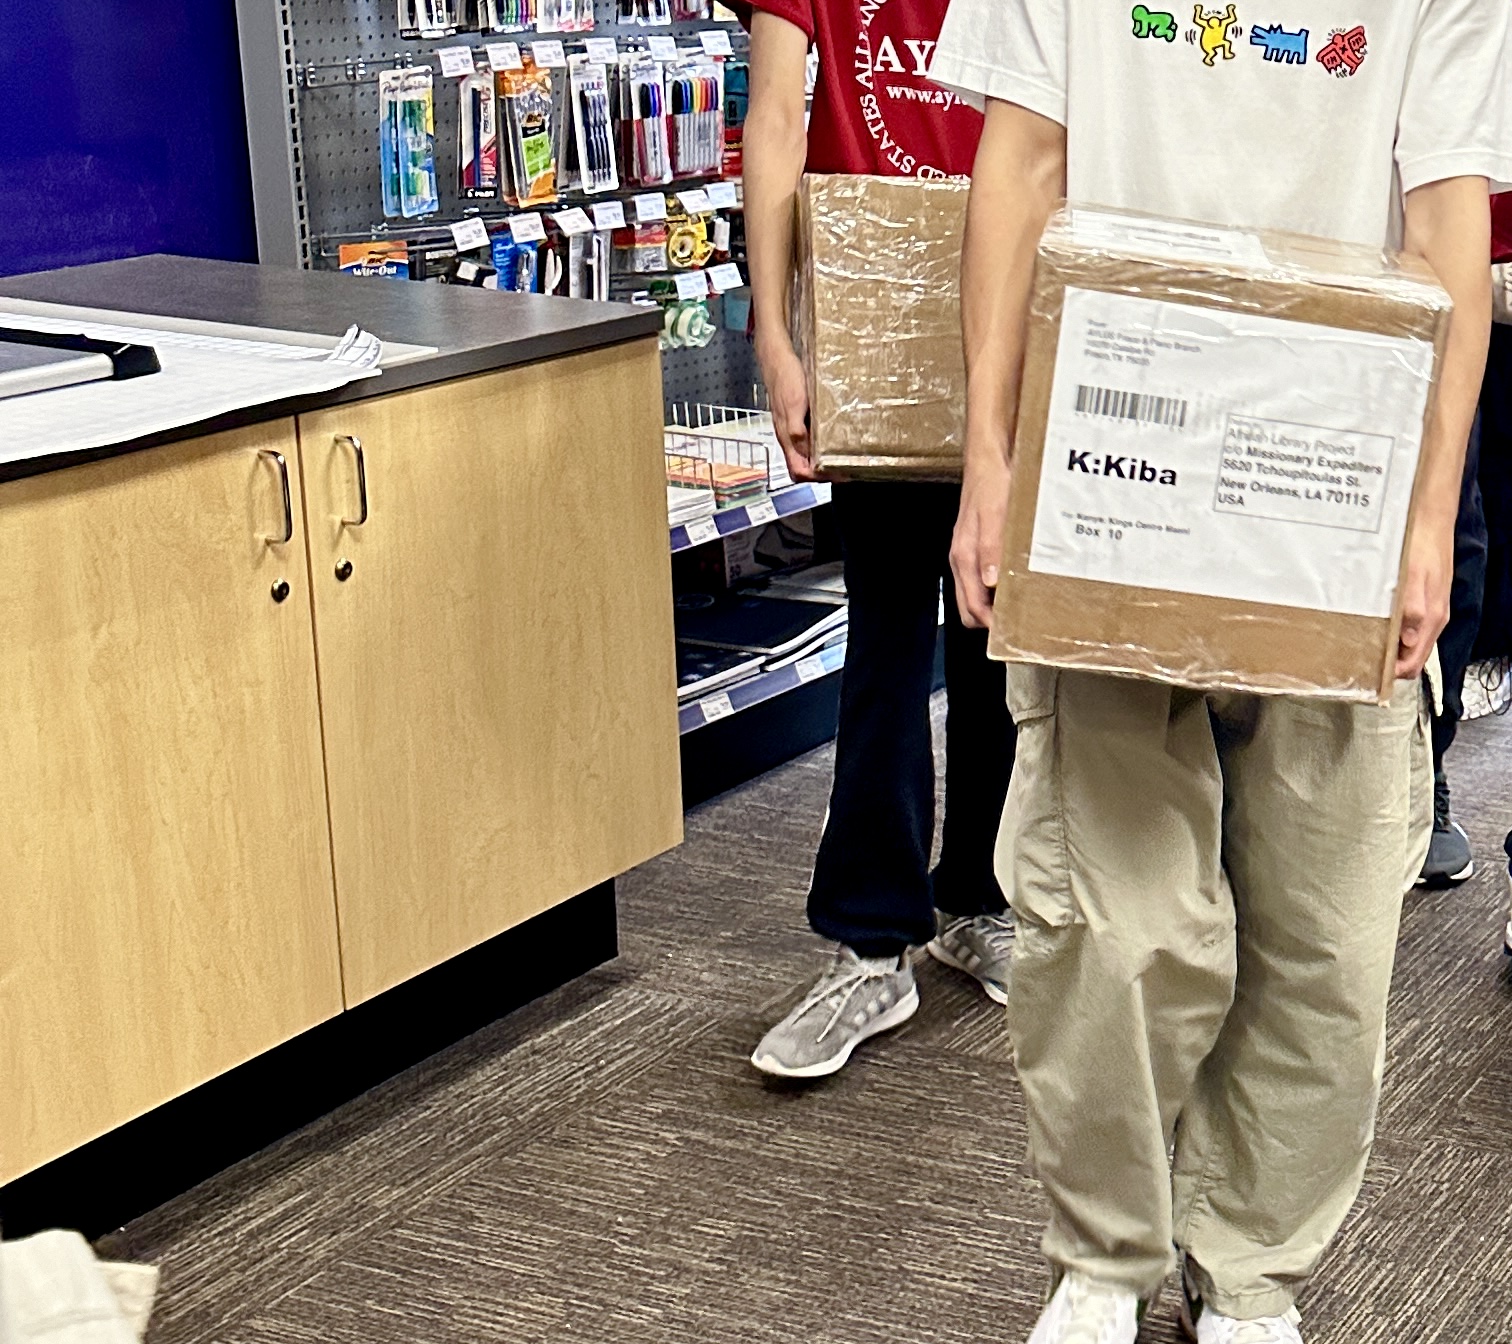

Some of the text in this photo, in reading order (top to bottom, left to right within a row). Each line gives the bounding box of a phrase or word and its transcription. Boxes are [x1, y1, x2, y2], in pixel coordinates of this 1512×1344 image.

[860, 93, 917, 174] STATES
[1067, 448, 1178, 486] K:Kiba
[1218, 492, 1246, 507] USA
[1220, 477, 1248, 490] New
[1305, 487, 1322, 501] LA
[1325, 489, 1371, 508] 70115
[1075, 523, 1123, 541] Box 10
